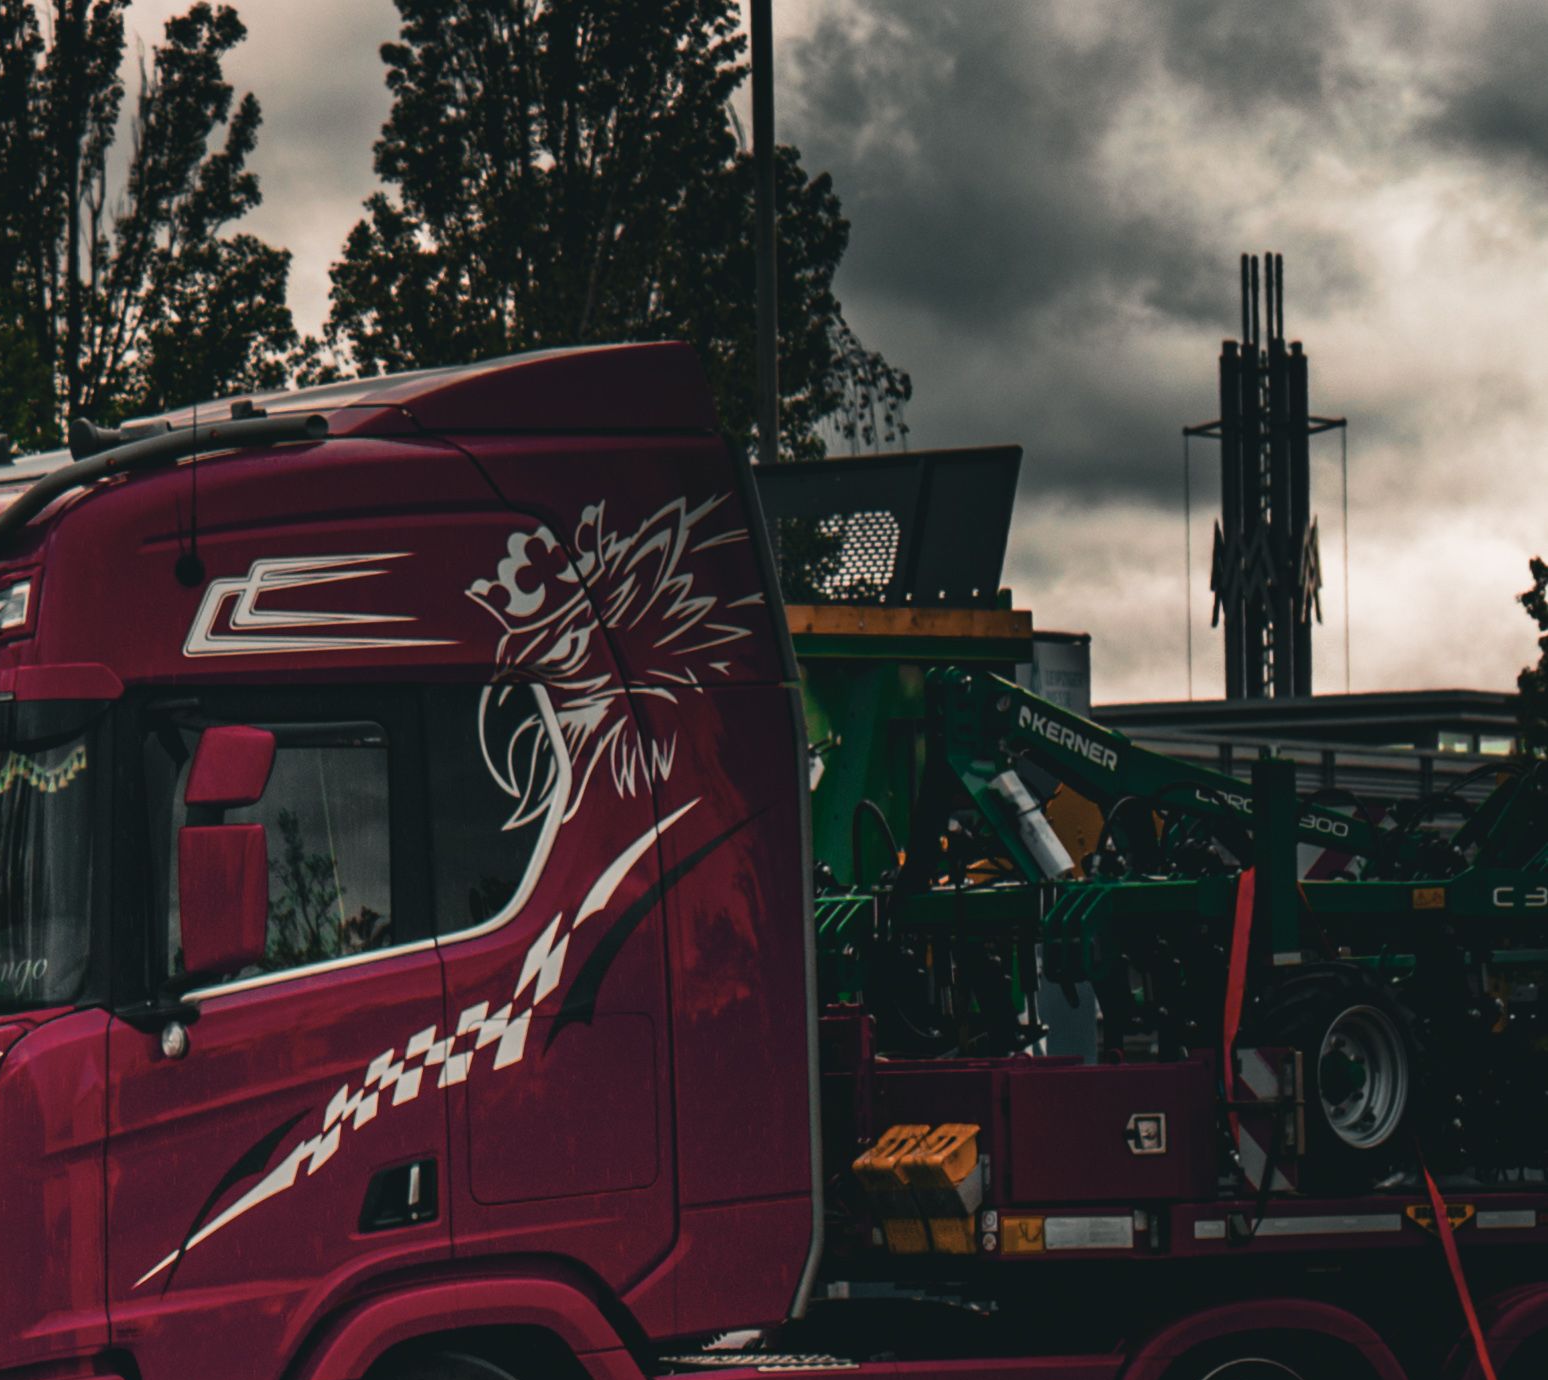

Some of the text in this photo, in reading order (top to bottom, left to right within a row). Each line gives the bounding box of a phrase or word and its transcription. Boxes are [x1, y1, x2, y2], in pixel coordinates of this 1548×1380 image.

[1031, 711, 1118, 772] KERNER
[1299, 814, 1349, 838] 300
[1493, 886, 1515, 908] C
